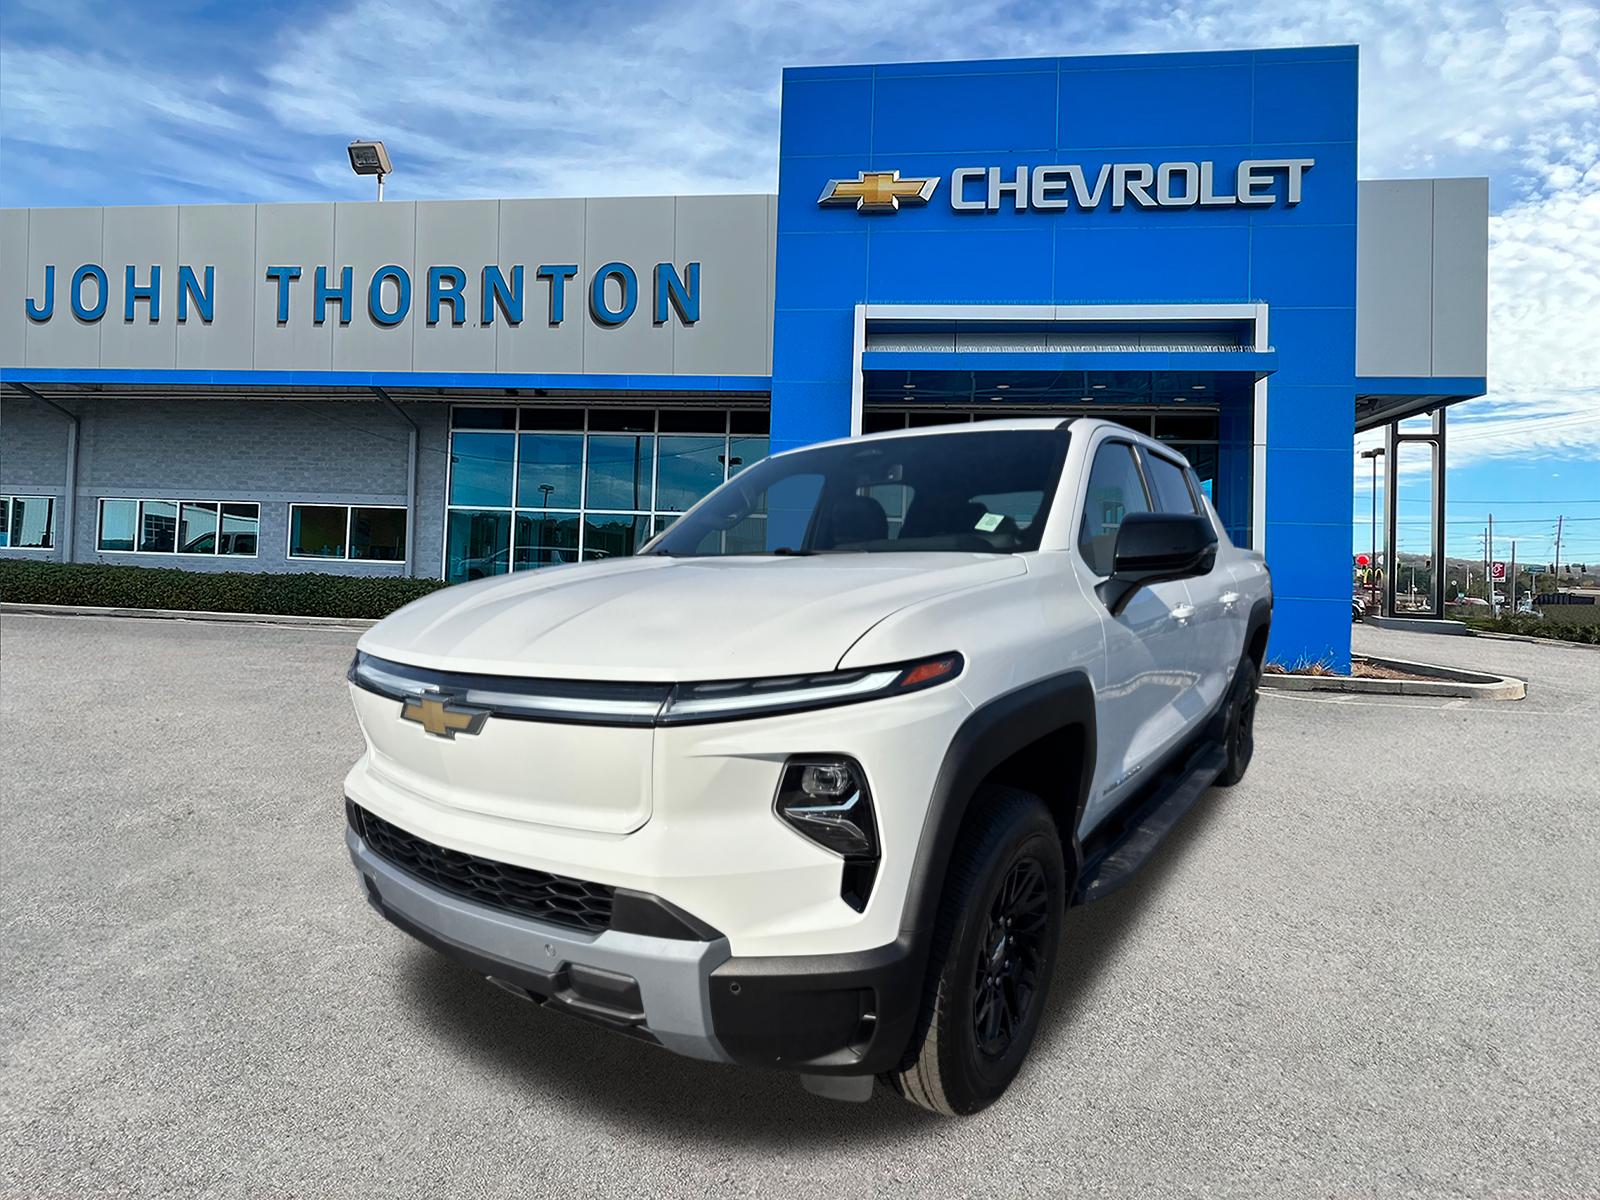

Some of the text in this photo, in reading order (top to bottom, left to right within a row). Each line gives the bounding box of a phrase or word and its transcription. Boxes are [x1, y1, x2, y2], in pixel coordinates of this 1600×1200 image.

[951, 158, 1316, 212] CHEVROLET
[26, 262, 702, 327] JOHN THORNTON
